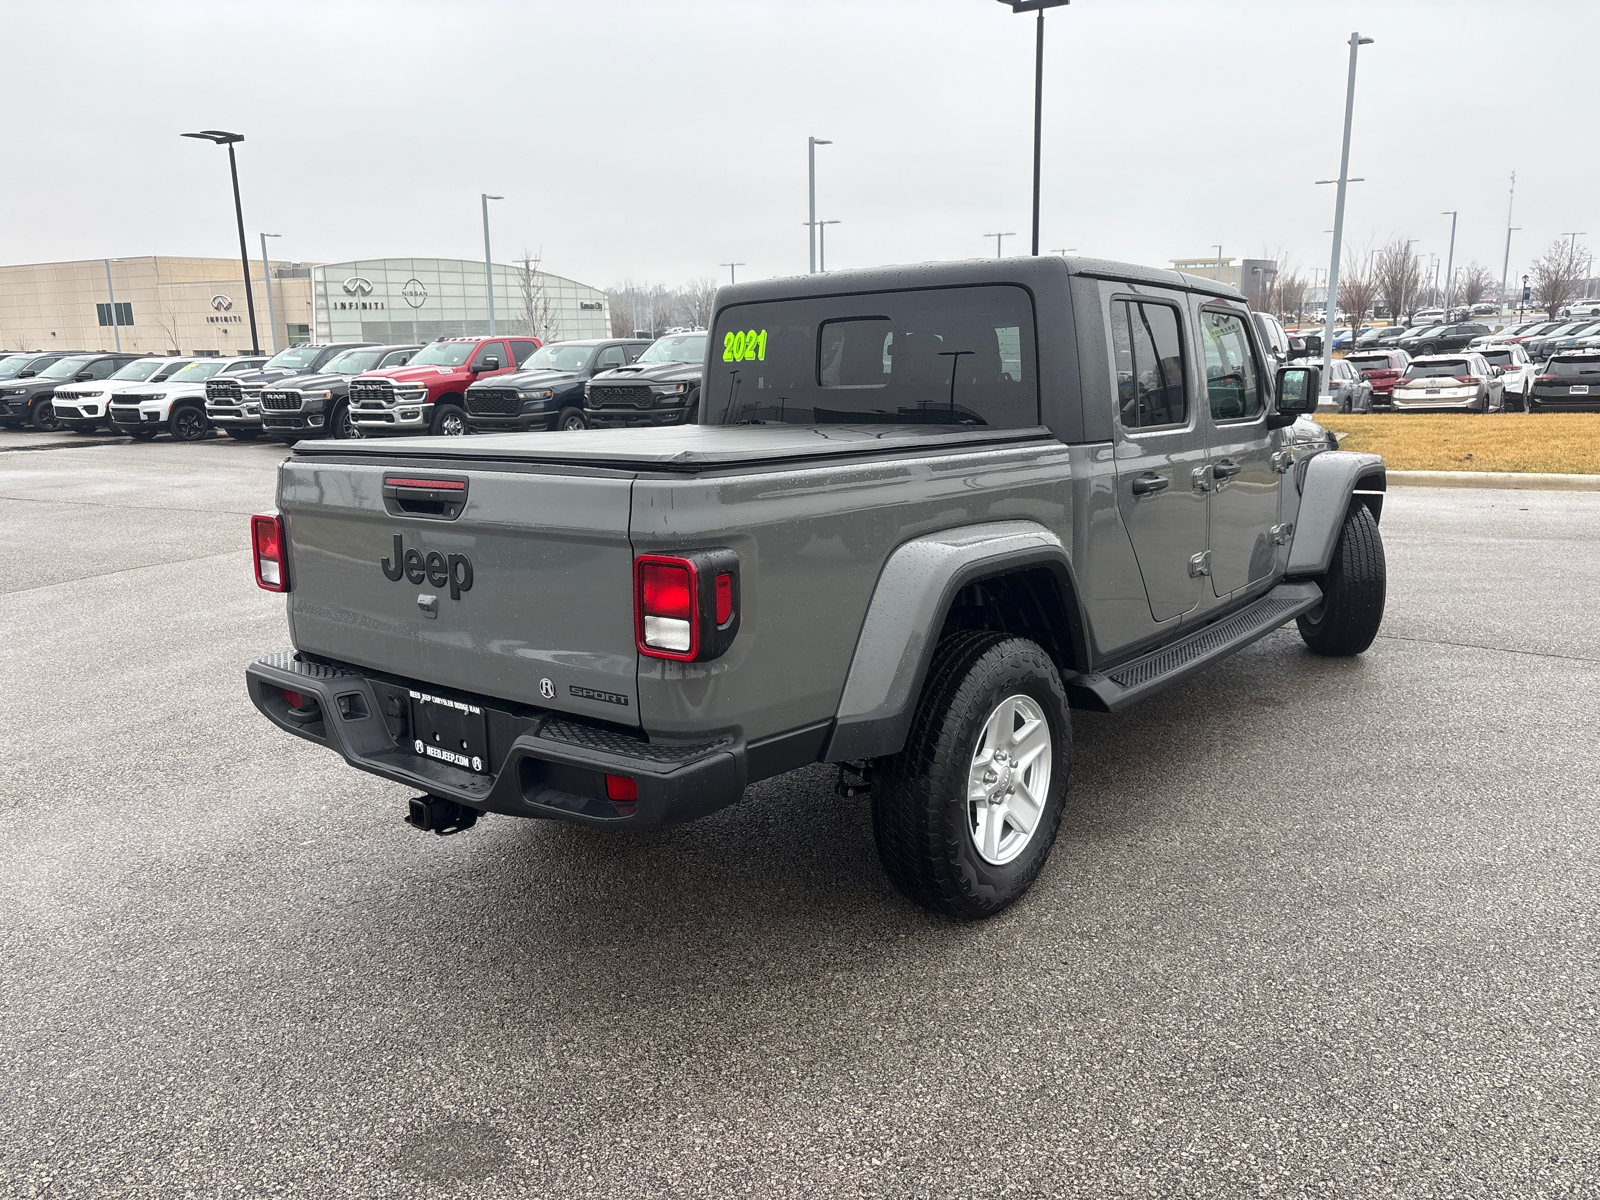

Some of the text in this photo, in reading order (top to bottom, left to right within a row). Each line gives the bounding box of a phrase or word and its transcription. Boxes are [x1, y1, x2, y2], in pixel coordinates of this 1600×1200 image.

[334, 302, 385, 310] INFINITI
[206, 315, 242, 323] INFINITI
[723, 330, 767, 362] 2021
[601, 387, 634, 395] RAM
[381, 533, 473, 601] Jeep
[570, 686, 628, 704] SPORT
[431, 695, 454, 708] CHRYSLER
[469, 705, 481, 715] RAM
[426, 746, 469, 767] REEDJEEP.COM
